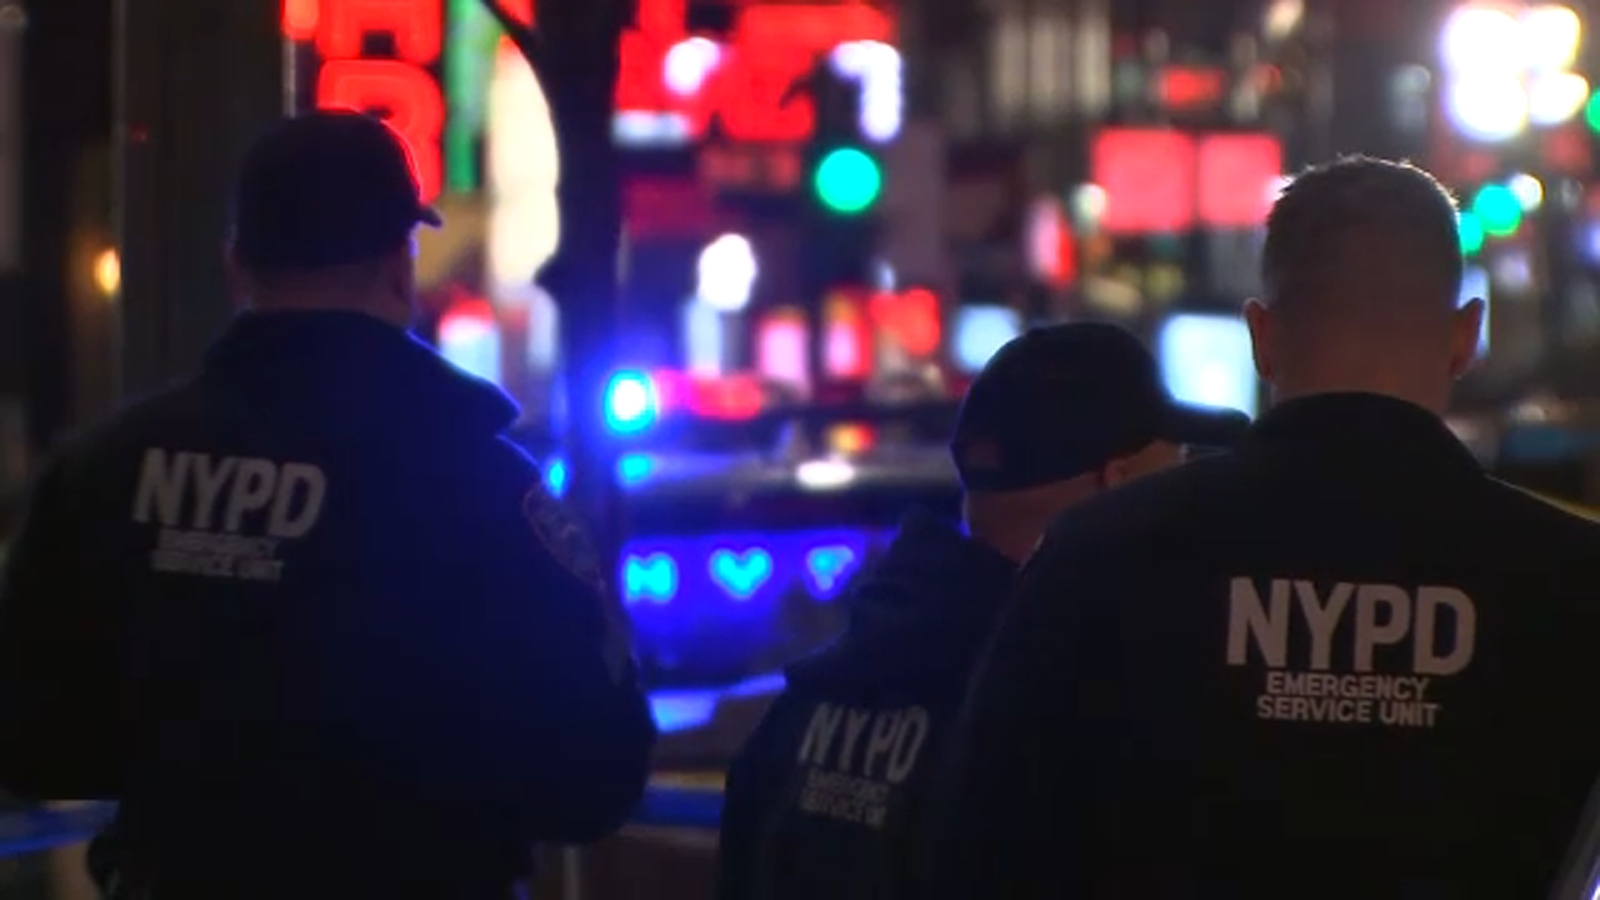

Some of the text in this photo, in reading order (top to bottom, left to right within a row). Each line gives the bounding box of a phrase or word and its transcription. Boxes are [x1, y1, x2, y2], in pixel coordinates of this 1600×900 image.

[132, 446, 328, 539] NYPD
[1226, 577, 1477, 676] NYPD
[1256, 695, 1440, 728] SERVICE UNIT
[1266, 671, 1430, 701] EMERGENCY
[798, 702, 930, 784] NYPD
